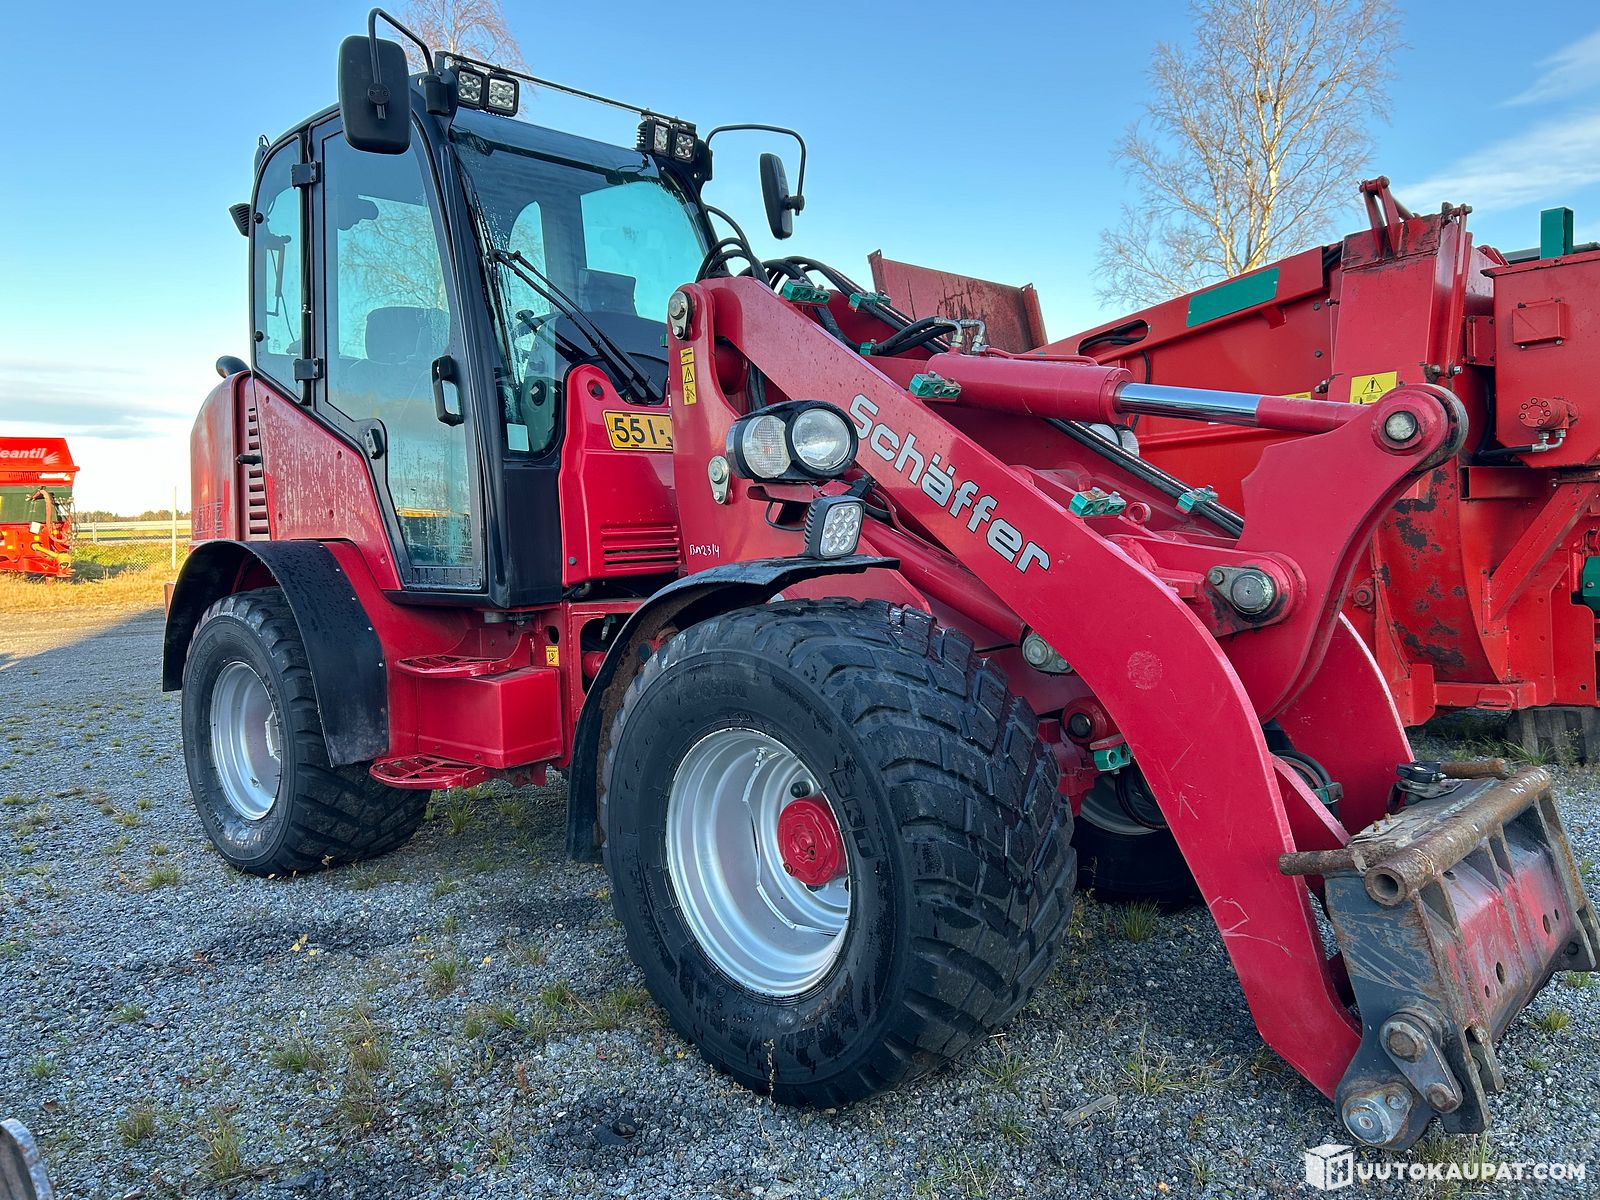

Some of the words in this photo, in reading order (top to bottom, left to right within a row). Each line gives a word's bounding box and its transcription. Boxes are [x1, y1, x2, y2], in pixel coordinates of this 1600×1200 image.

[613, 416, 673, 447] 551-
[0, 447, 47, 459] eantil
[849, 393, 1051, 574] Schäffer
